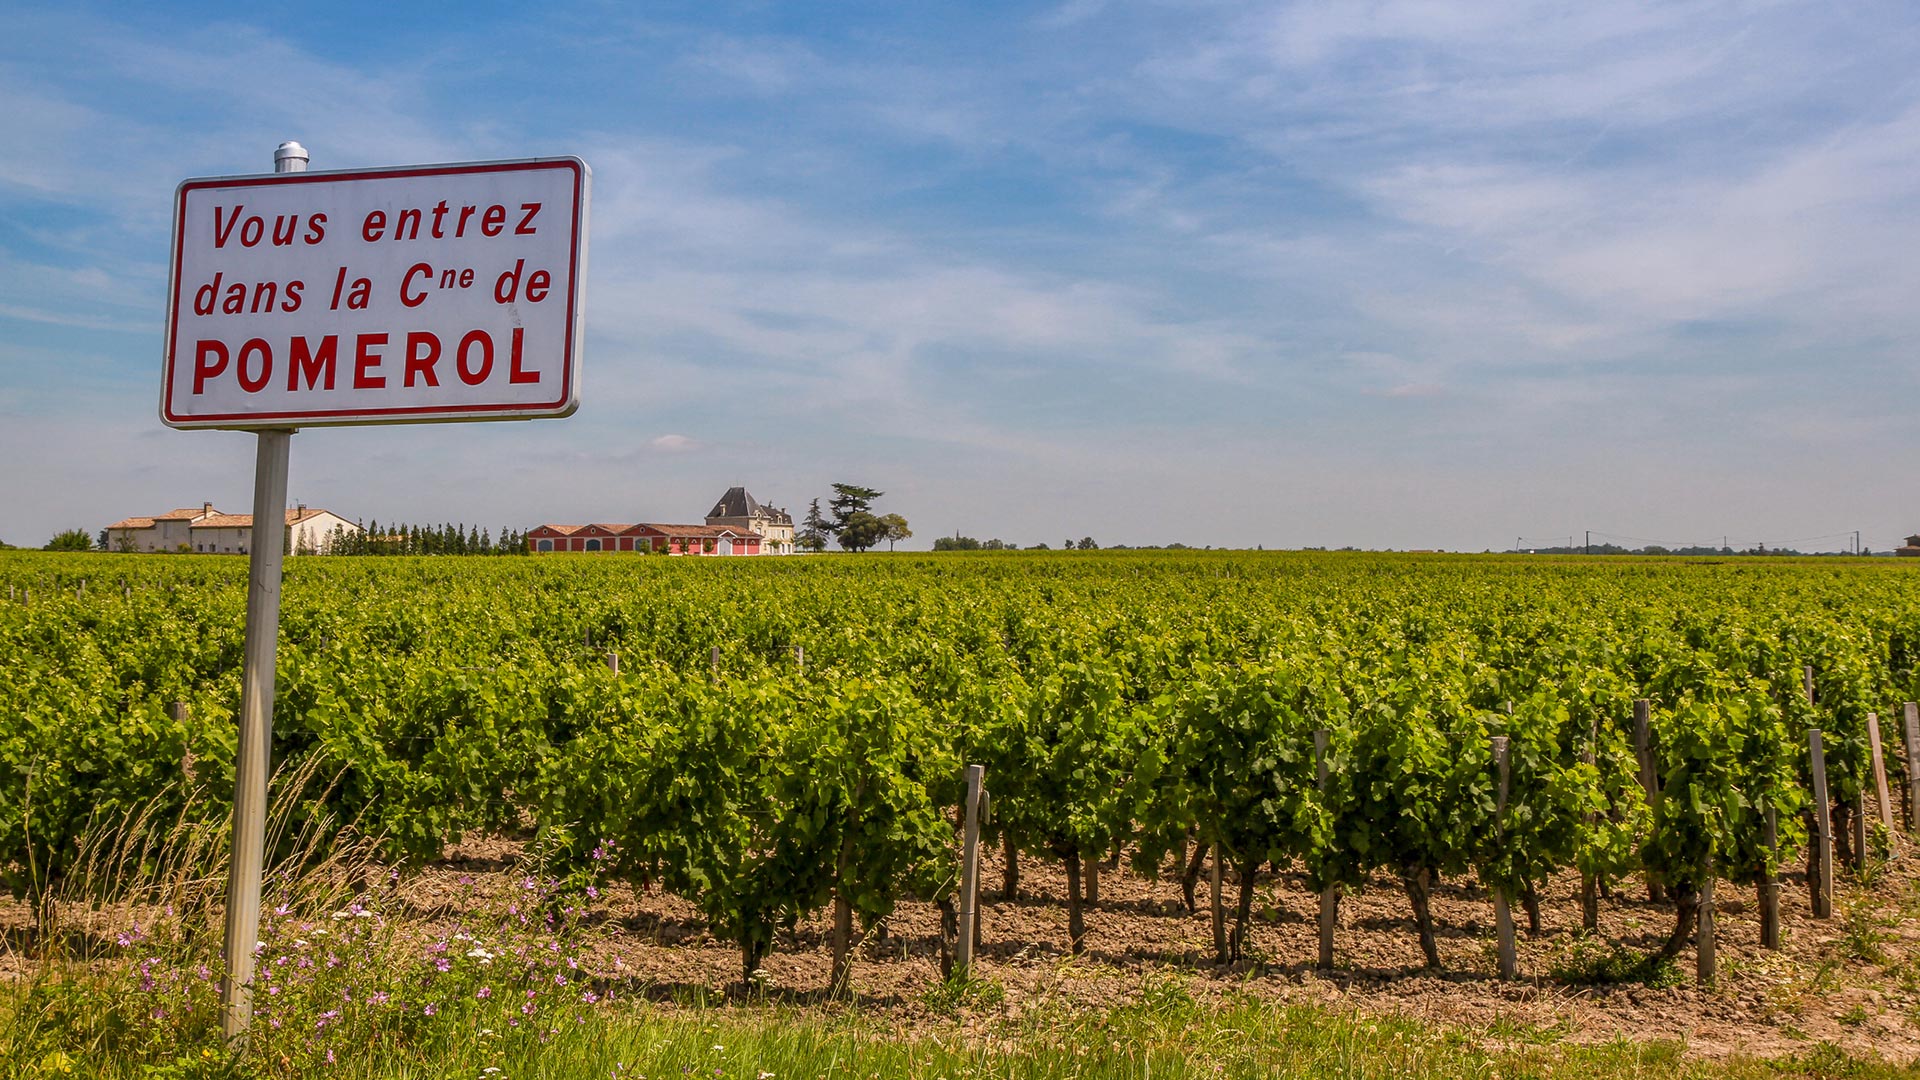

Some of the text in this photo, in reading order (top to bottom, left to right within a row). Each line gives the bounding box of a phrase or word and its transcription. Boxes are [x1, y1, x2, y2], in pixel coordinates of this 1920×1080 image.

[214, 200, 542, 248] Vous entrez
[193, 258, 551, 316] dans la Cne de
[193, 327, 541, 395] POMEROL
